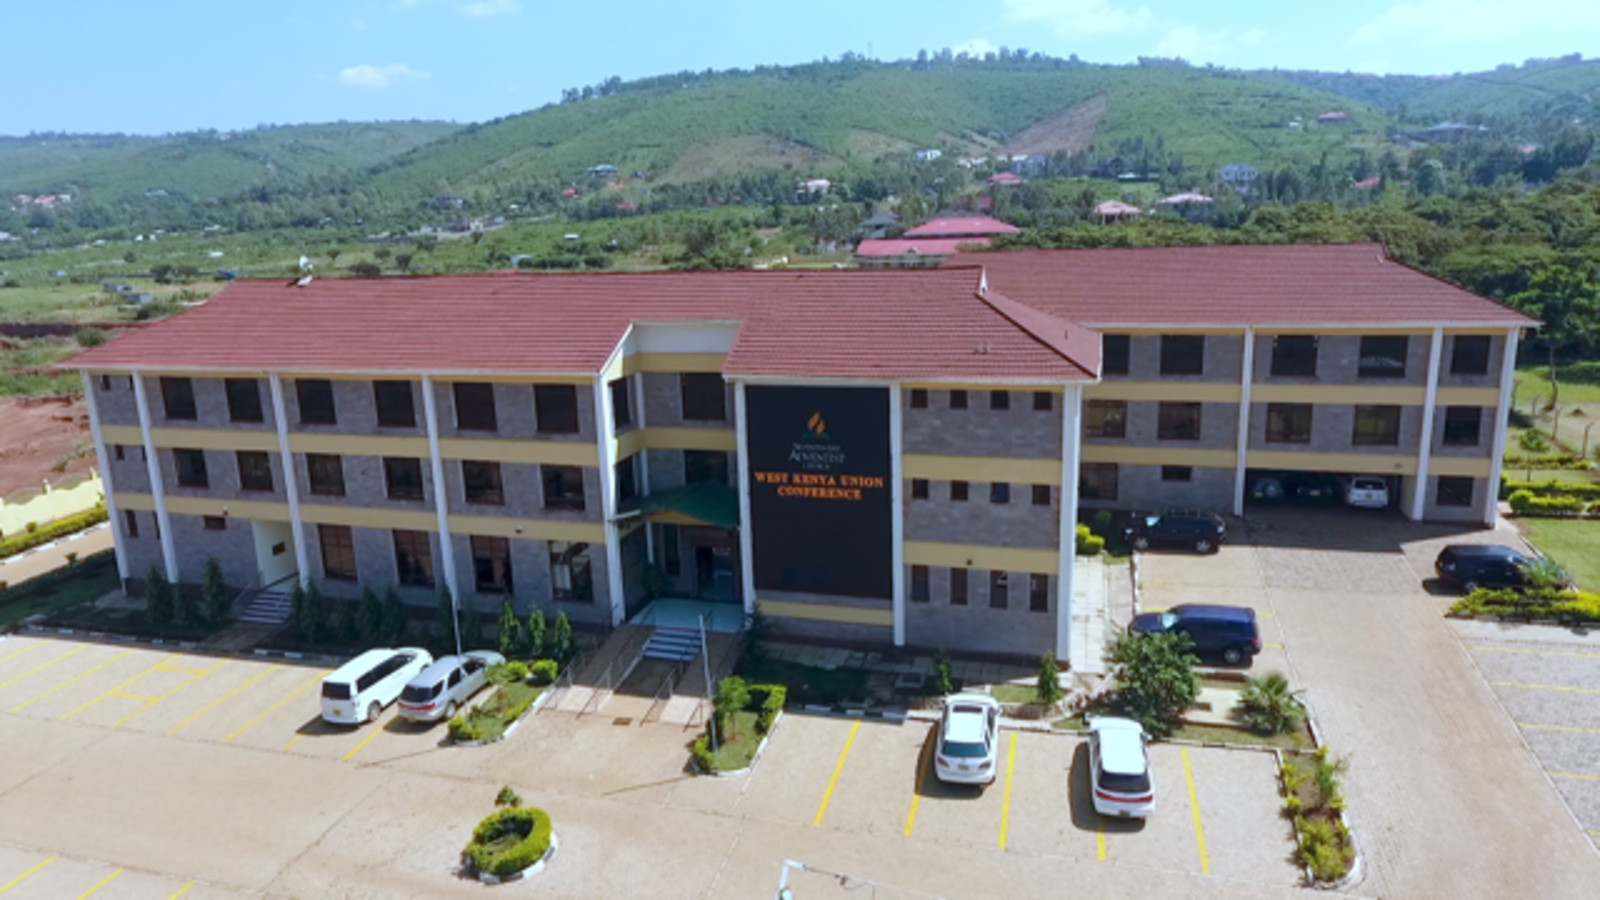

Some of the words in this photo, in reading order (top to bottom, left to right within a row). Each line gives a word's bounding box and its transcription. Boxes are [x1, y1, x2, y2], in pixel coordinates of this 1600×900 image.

[754, 471, 788, 483] WEST
[793, 473, 836, 485] KENYA
[840, 475, 884, 488] UNION
[777, 486, 863, 500] CONFERENCE
